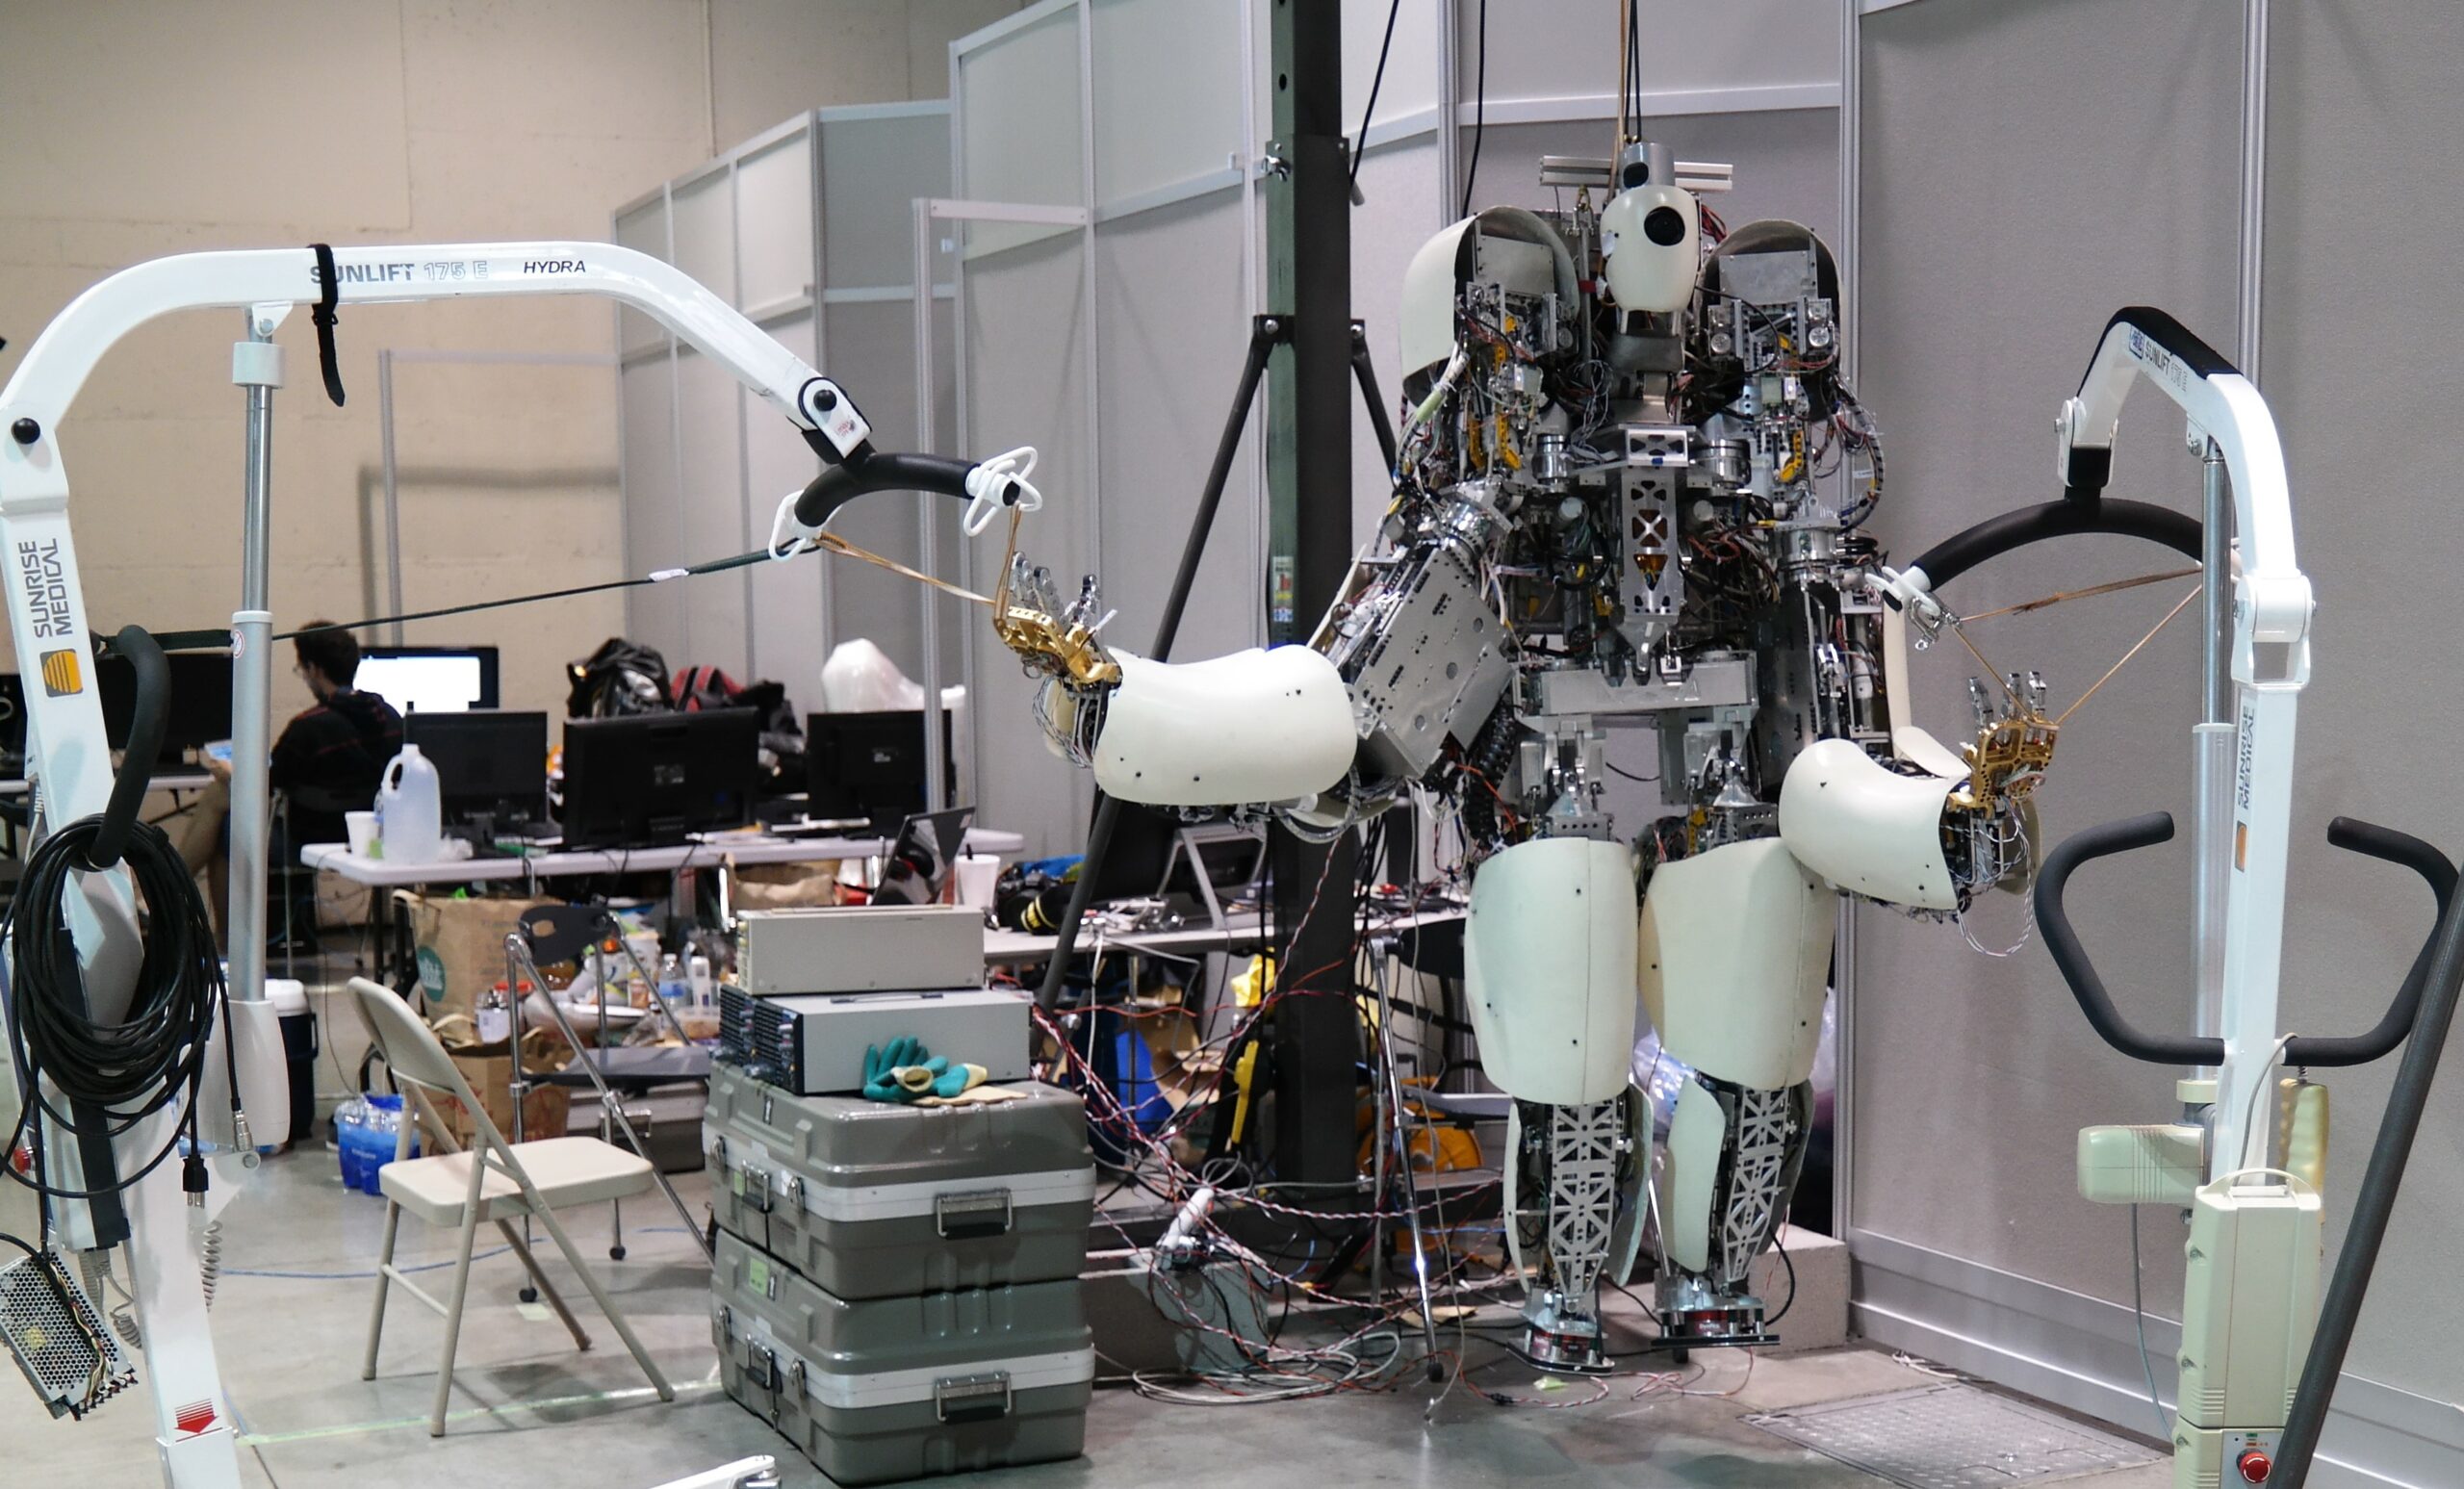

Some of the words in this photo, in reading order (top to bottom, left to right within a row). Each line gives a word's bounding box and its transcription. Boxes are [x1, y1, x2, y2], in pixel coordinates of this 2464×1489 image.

[424, 261, 466, 281] 175
[473, 260, 489, 280] E
[523, 260, 587, 274] HYDRA
[2144, 340, 2170, 375] SUNLIFT
[17, 541, 53, 638] SUNRISE
[40, 538, 73, 636] MEDICAL
[2238, 706, 2249, 807] SUNRISE
[2243, 707, 2254, 809] MEDICAL
